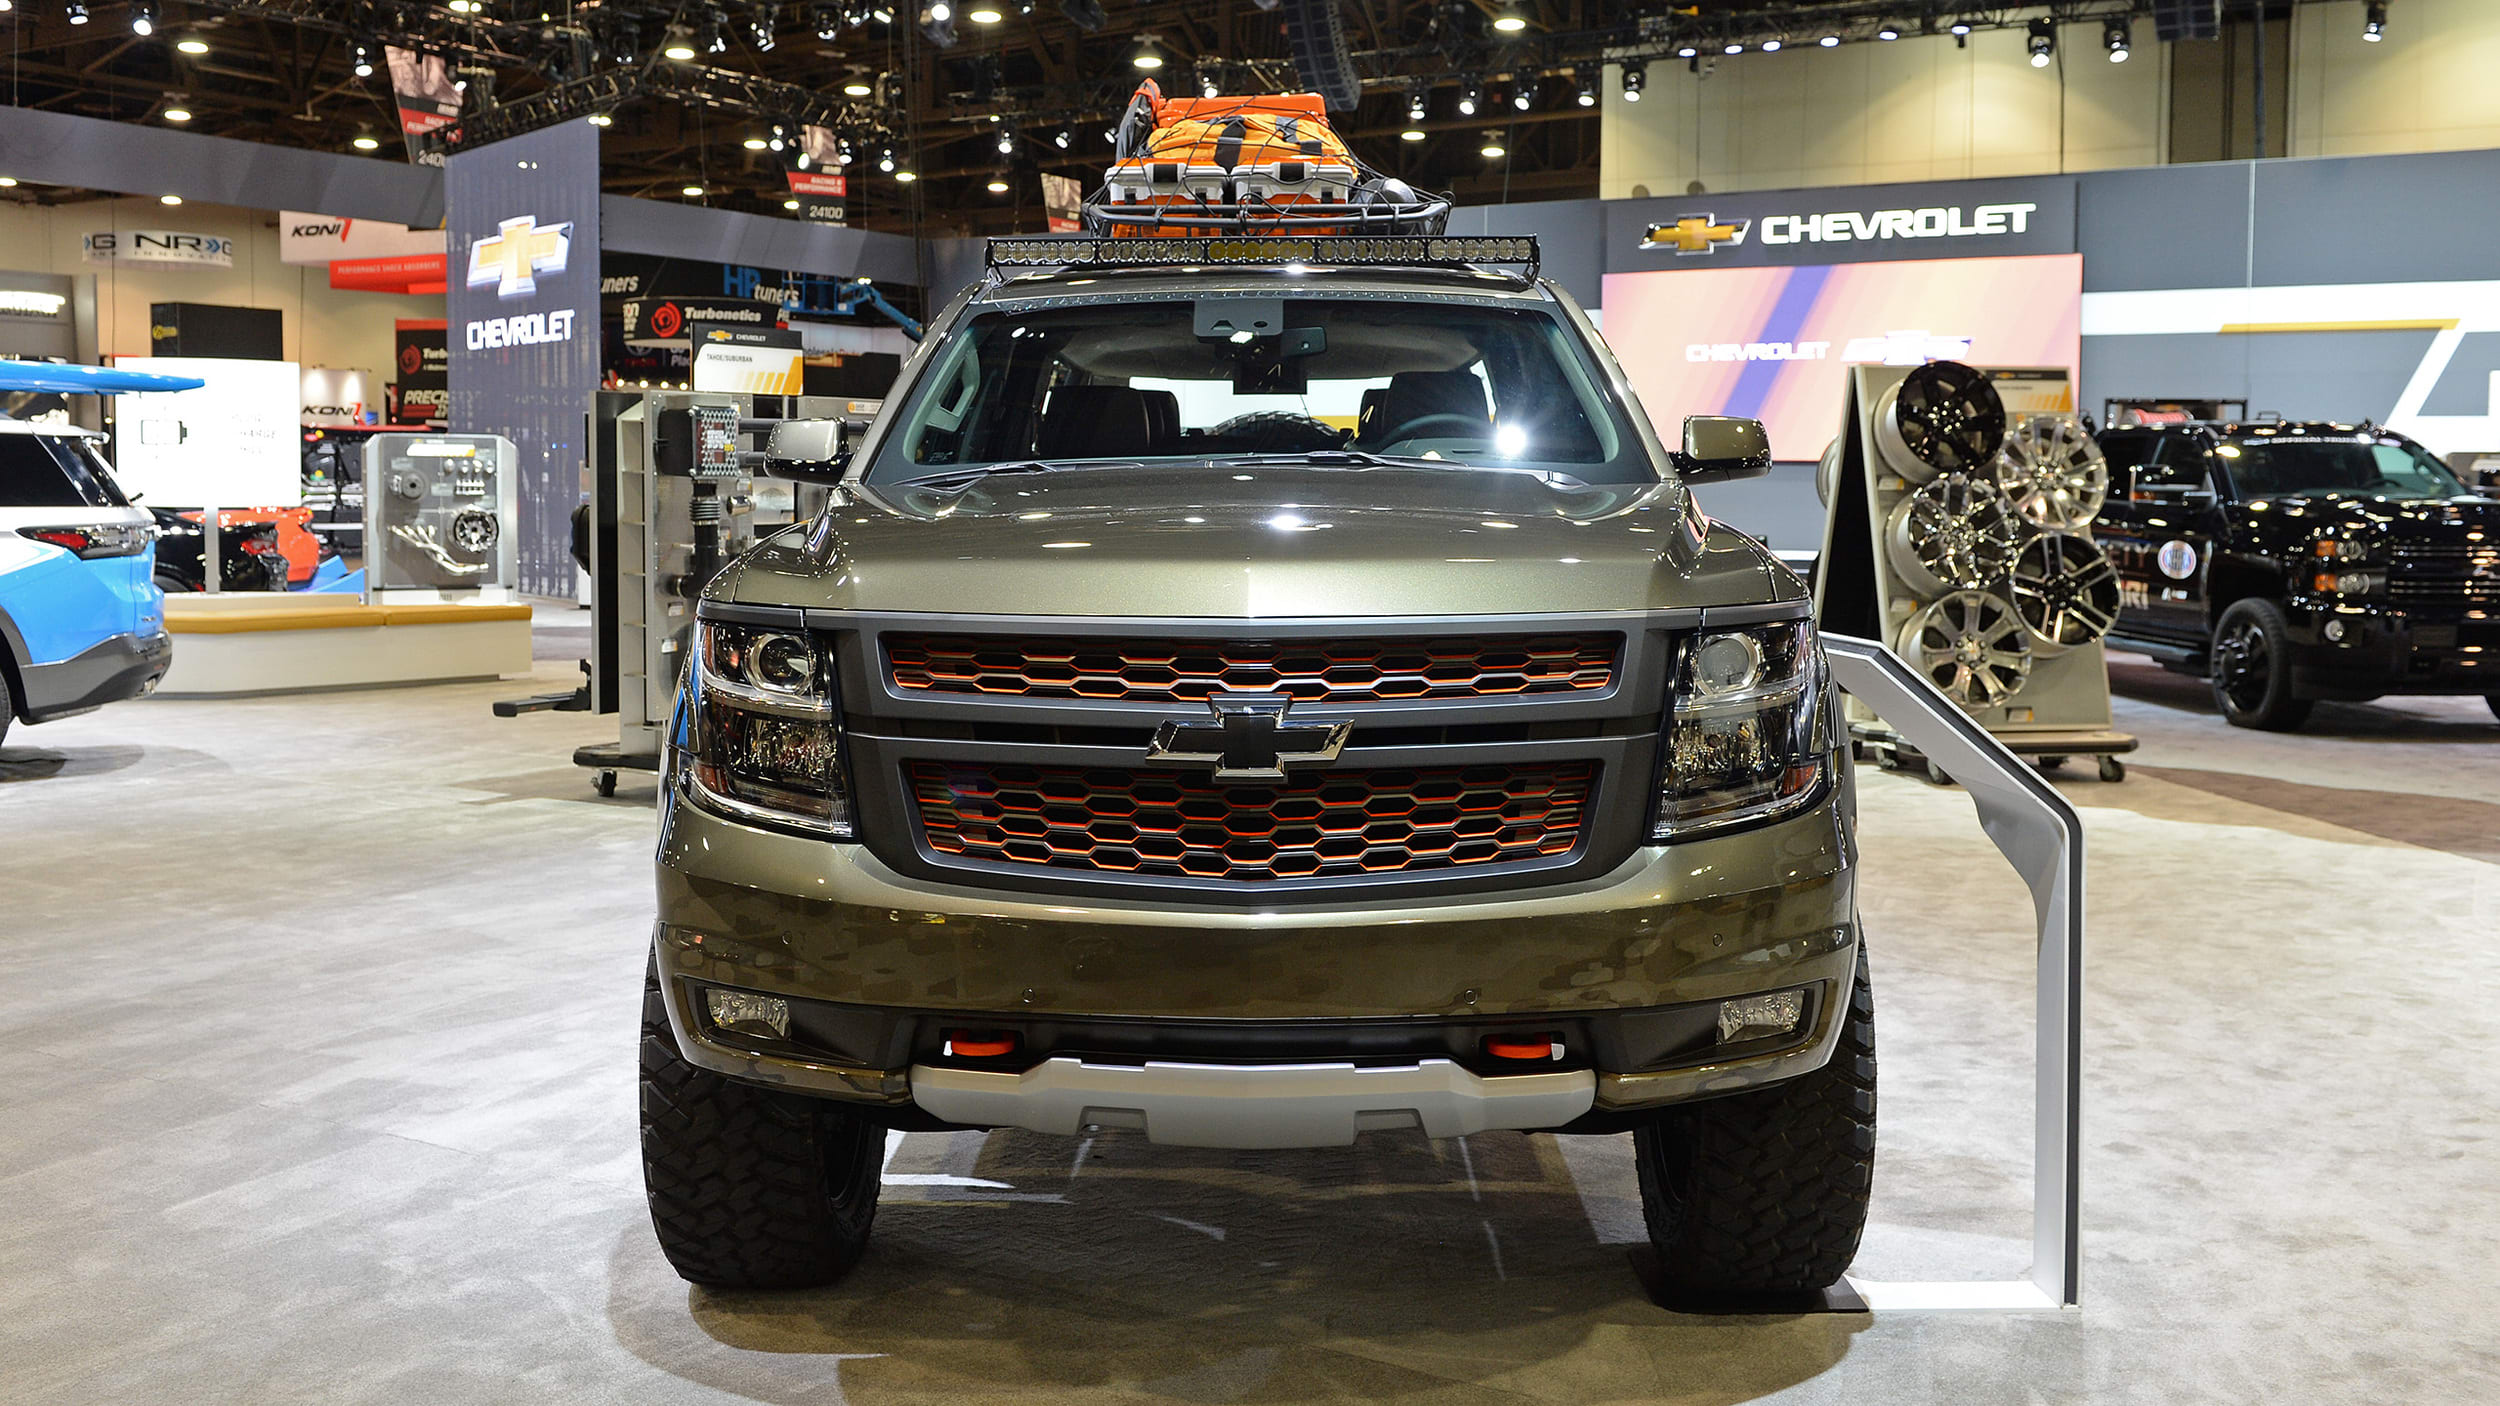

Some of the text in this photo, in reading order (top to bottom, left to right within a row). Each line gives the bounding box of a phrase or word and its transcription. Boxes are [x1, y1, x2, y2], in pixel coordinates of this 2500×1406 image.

[809, 205, 843, 219] 24100
[291, 223, 341, 238] KONI
[1761, 203, 2036, 244] CHEVROLET
[337, 265, 381, 274] PERFORMANCE
[723, 263, 761, 298] HP
[754, 283, 800, 303] tuners
[684, 306, 762, 322] Turbonetics
[466, 308, 576, 351] CHEVROLET
[1685, 341, 1831, 362] CHEVROLET
[302, 405, 353, 416] KONI
